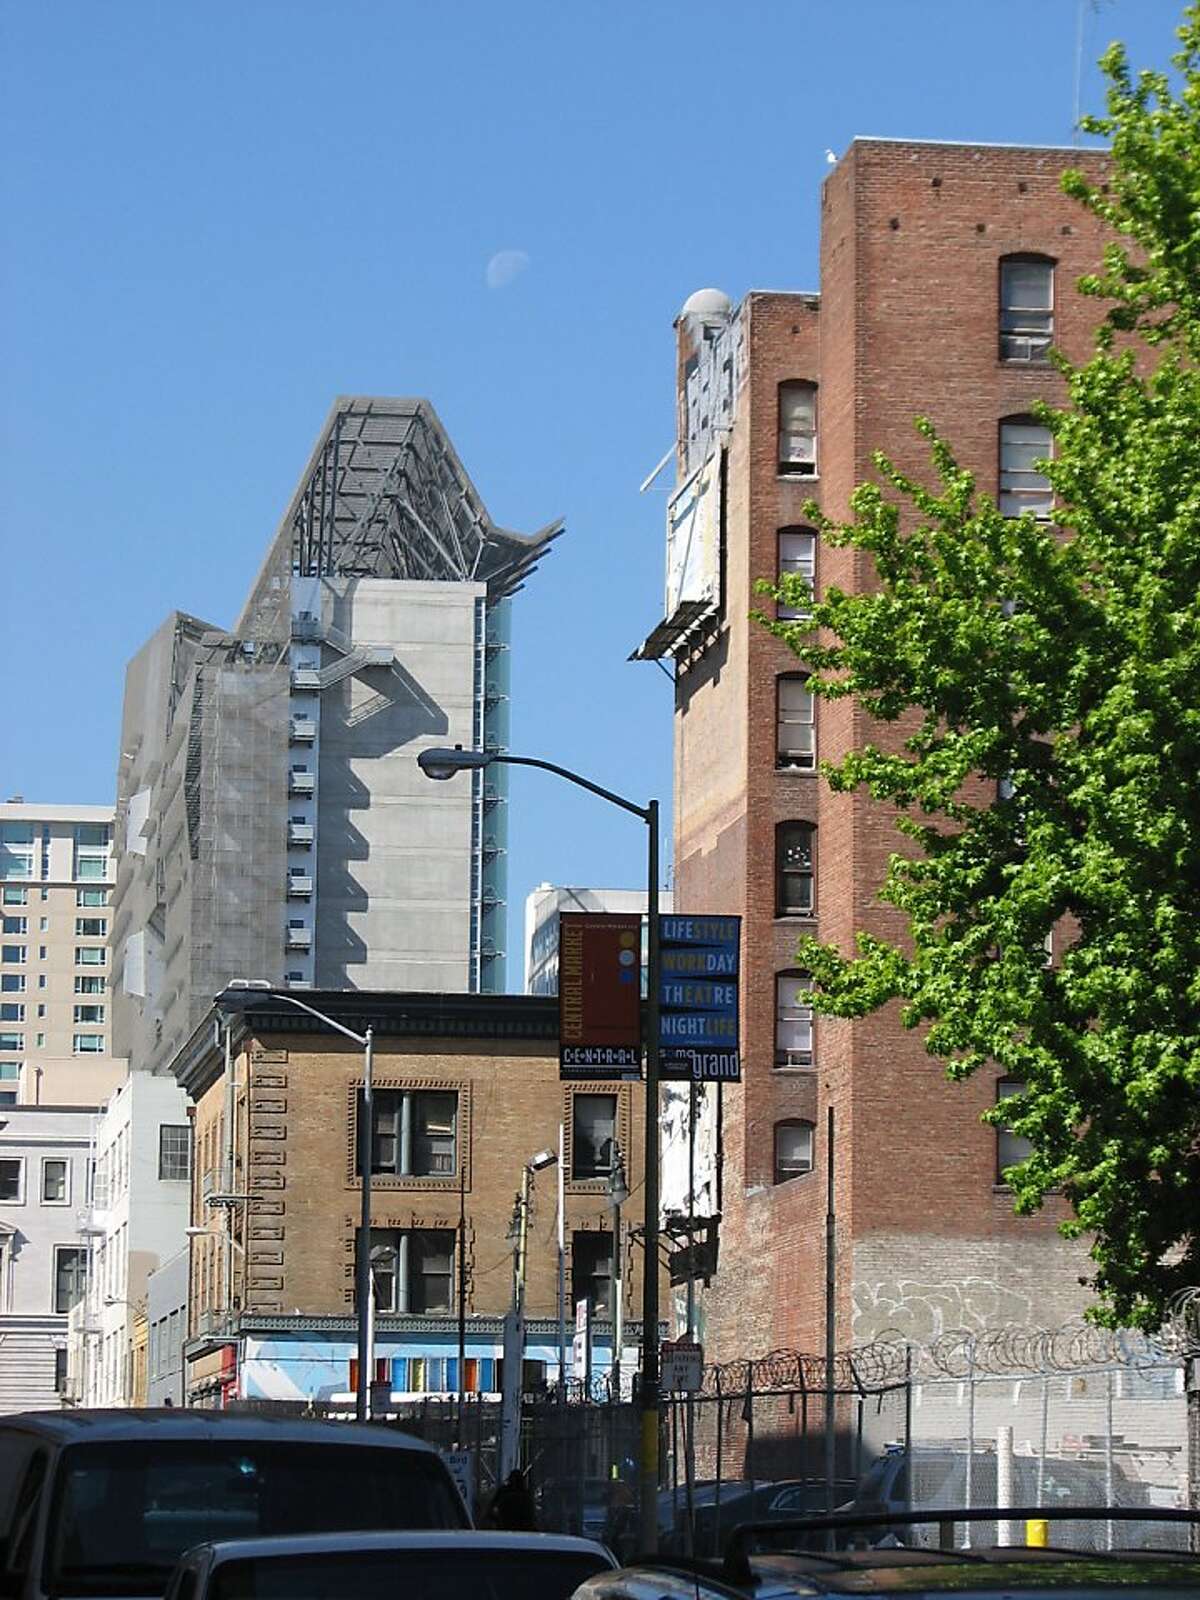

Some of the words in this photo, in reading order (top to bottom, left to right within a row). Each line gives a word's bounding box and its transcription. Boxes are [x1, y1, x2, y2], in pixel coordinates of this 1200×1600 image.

[663, 920, 736, 940] LIFESTYLE
[662, 953, 735, 973] WORKDAY
[664, 985, 734, 1004] THEATRE
[660, 1017, 735, 1036] NIGHTLIFE
[693, 1050, 738, 1079] grand
